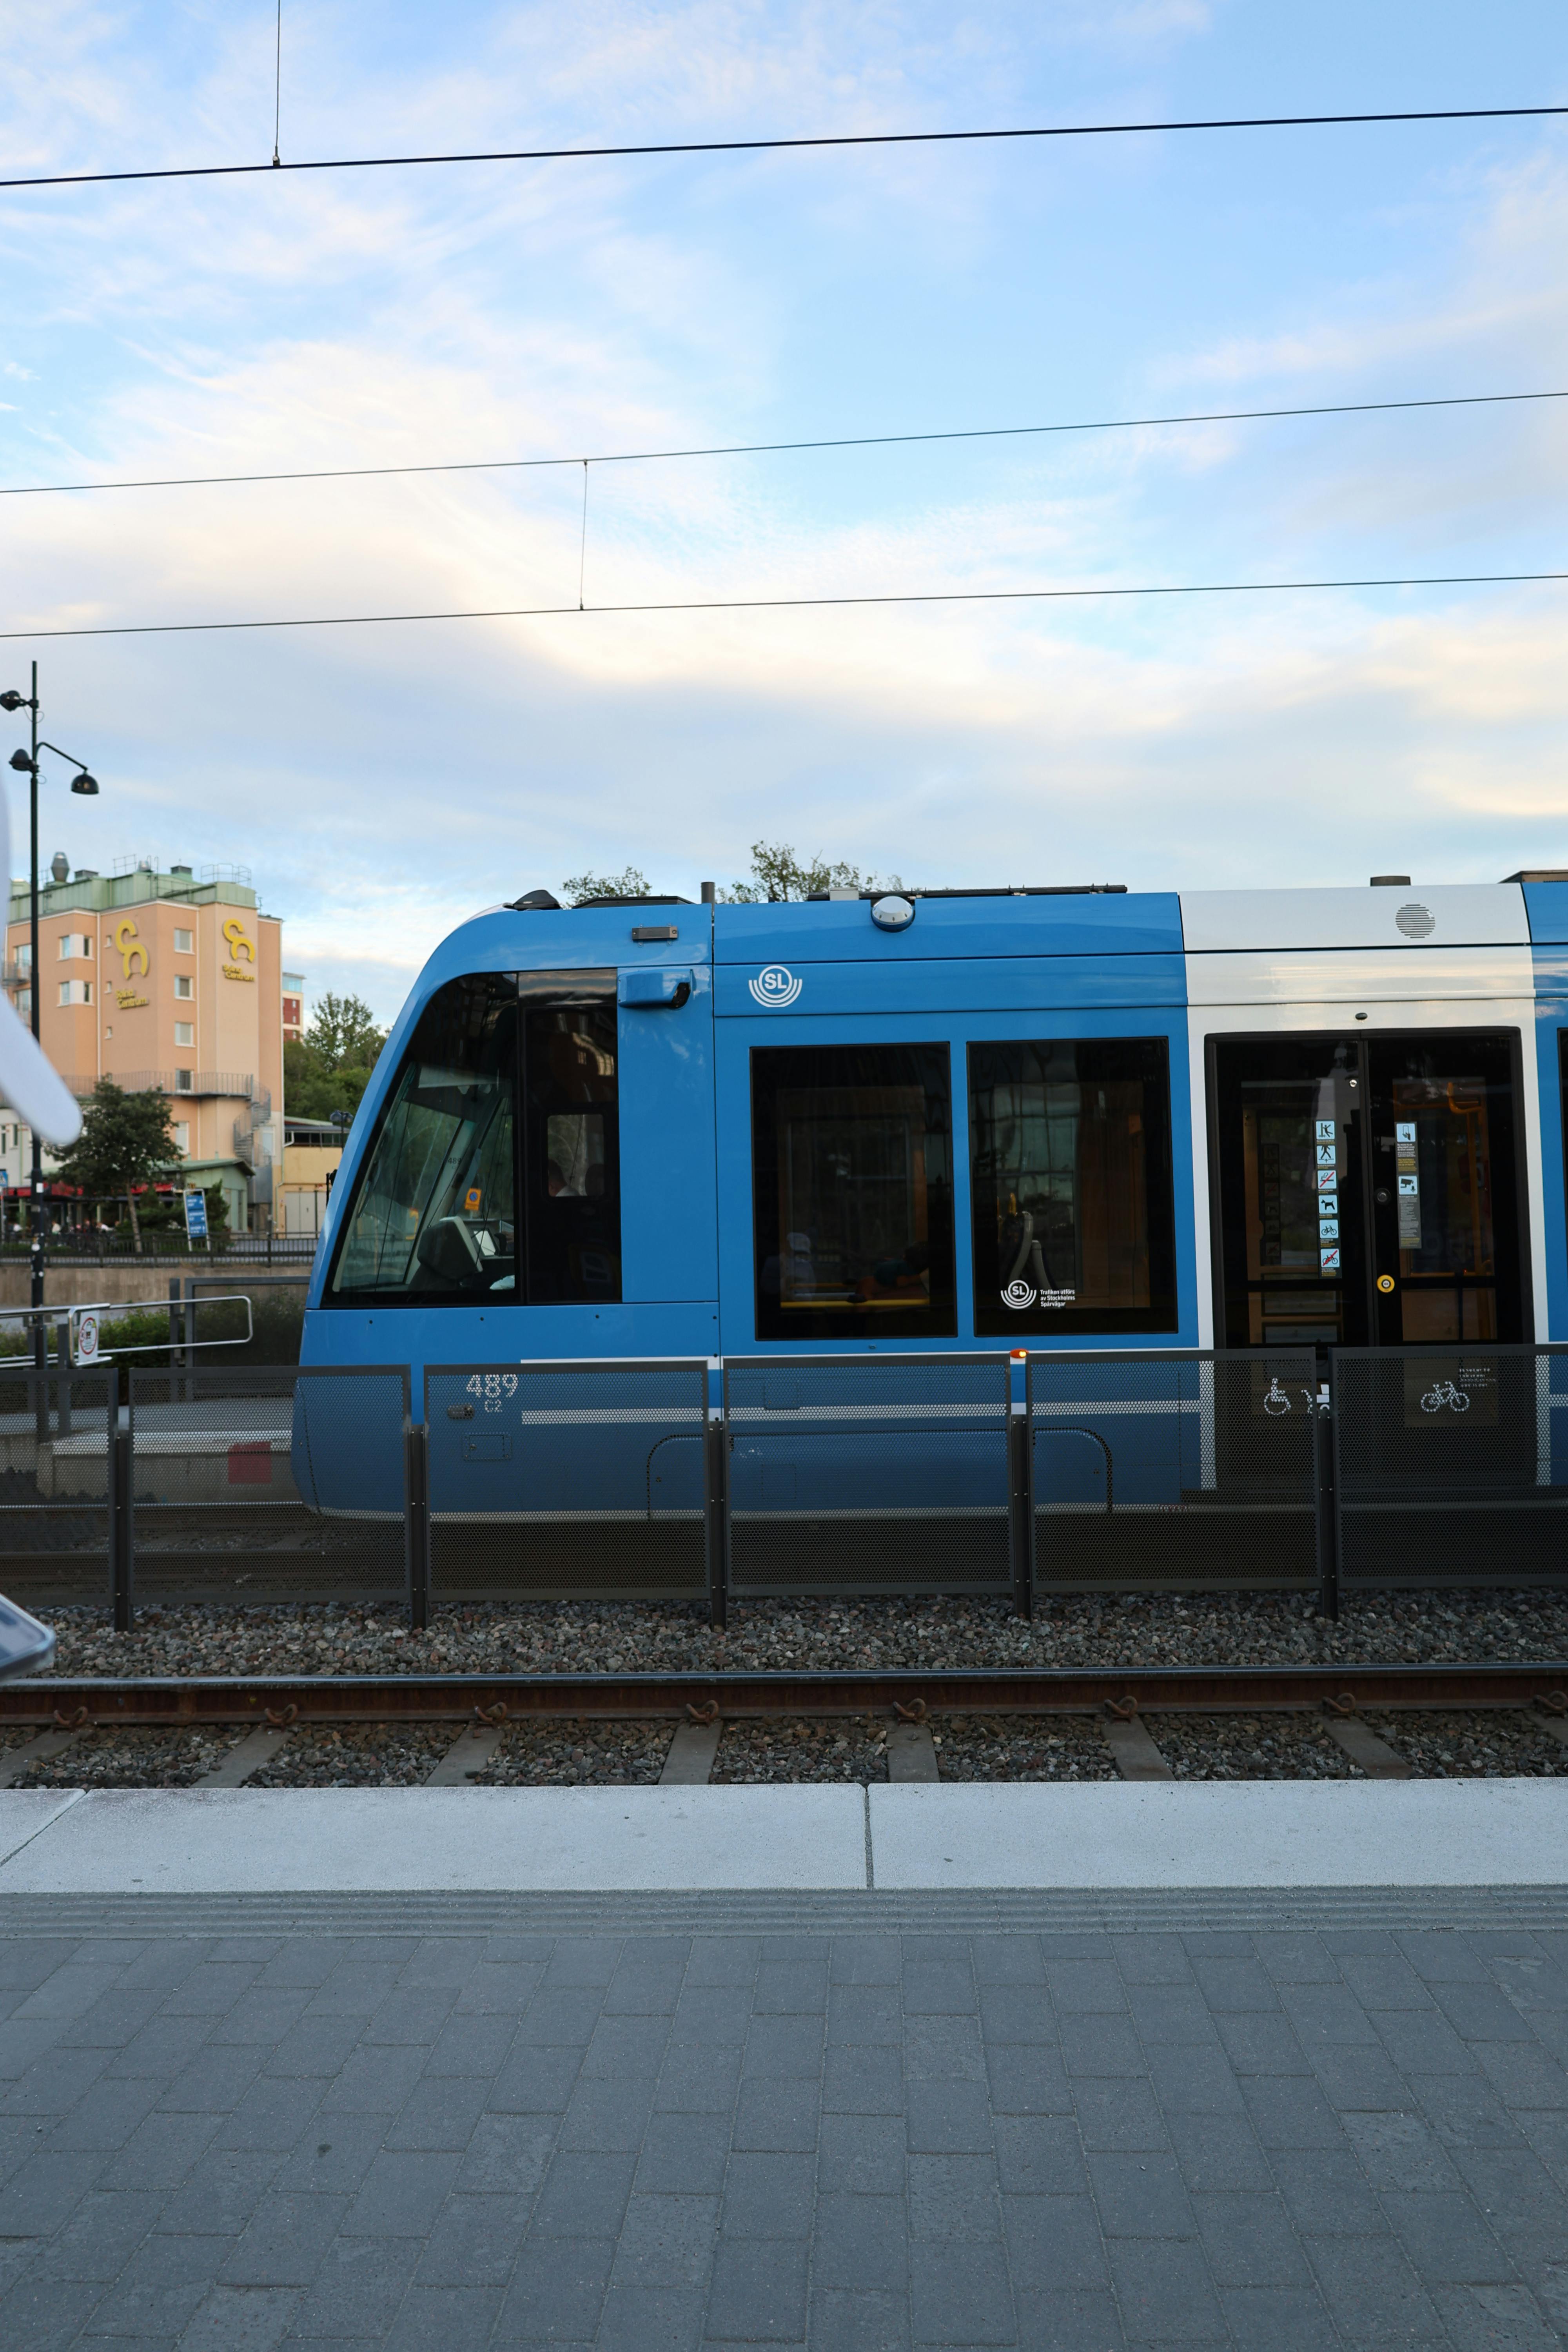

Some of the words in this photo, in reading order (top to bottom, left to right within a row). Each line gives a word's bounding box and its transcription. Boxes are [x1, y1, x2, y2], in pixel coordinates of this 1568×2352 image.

[226, 972, 255, 982] Centrum
[764, 973, 787, 990] SL
[1012, 1285, 1025, 1296] SL
[466, 1374, 518, 1398] 489
[485, 1399, 503, 1413] C2
